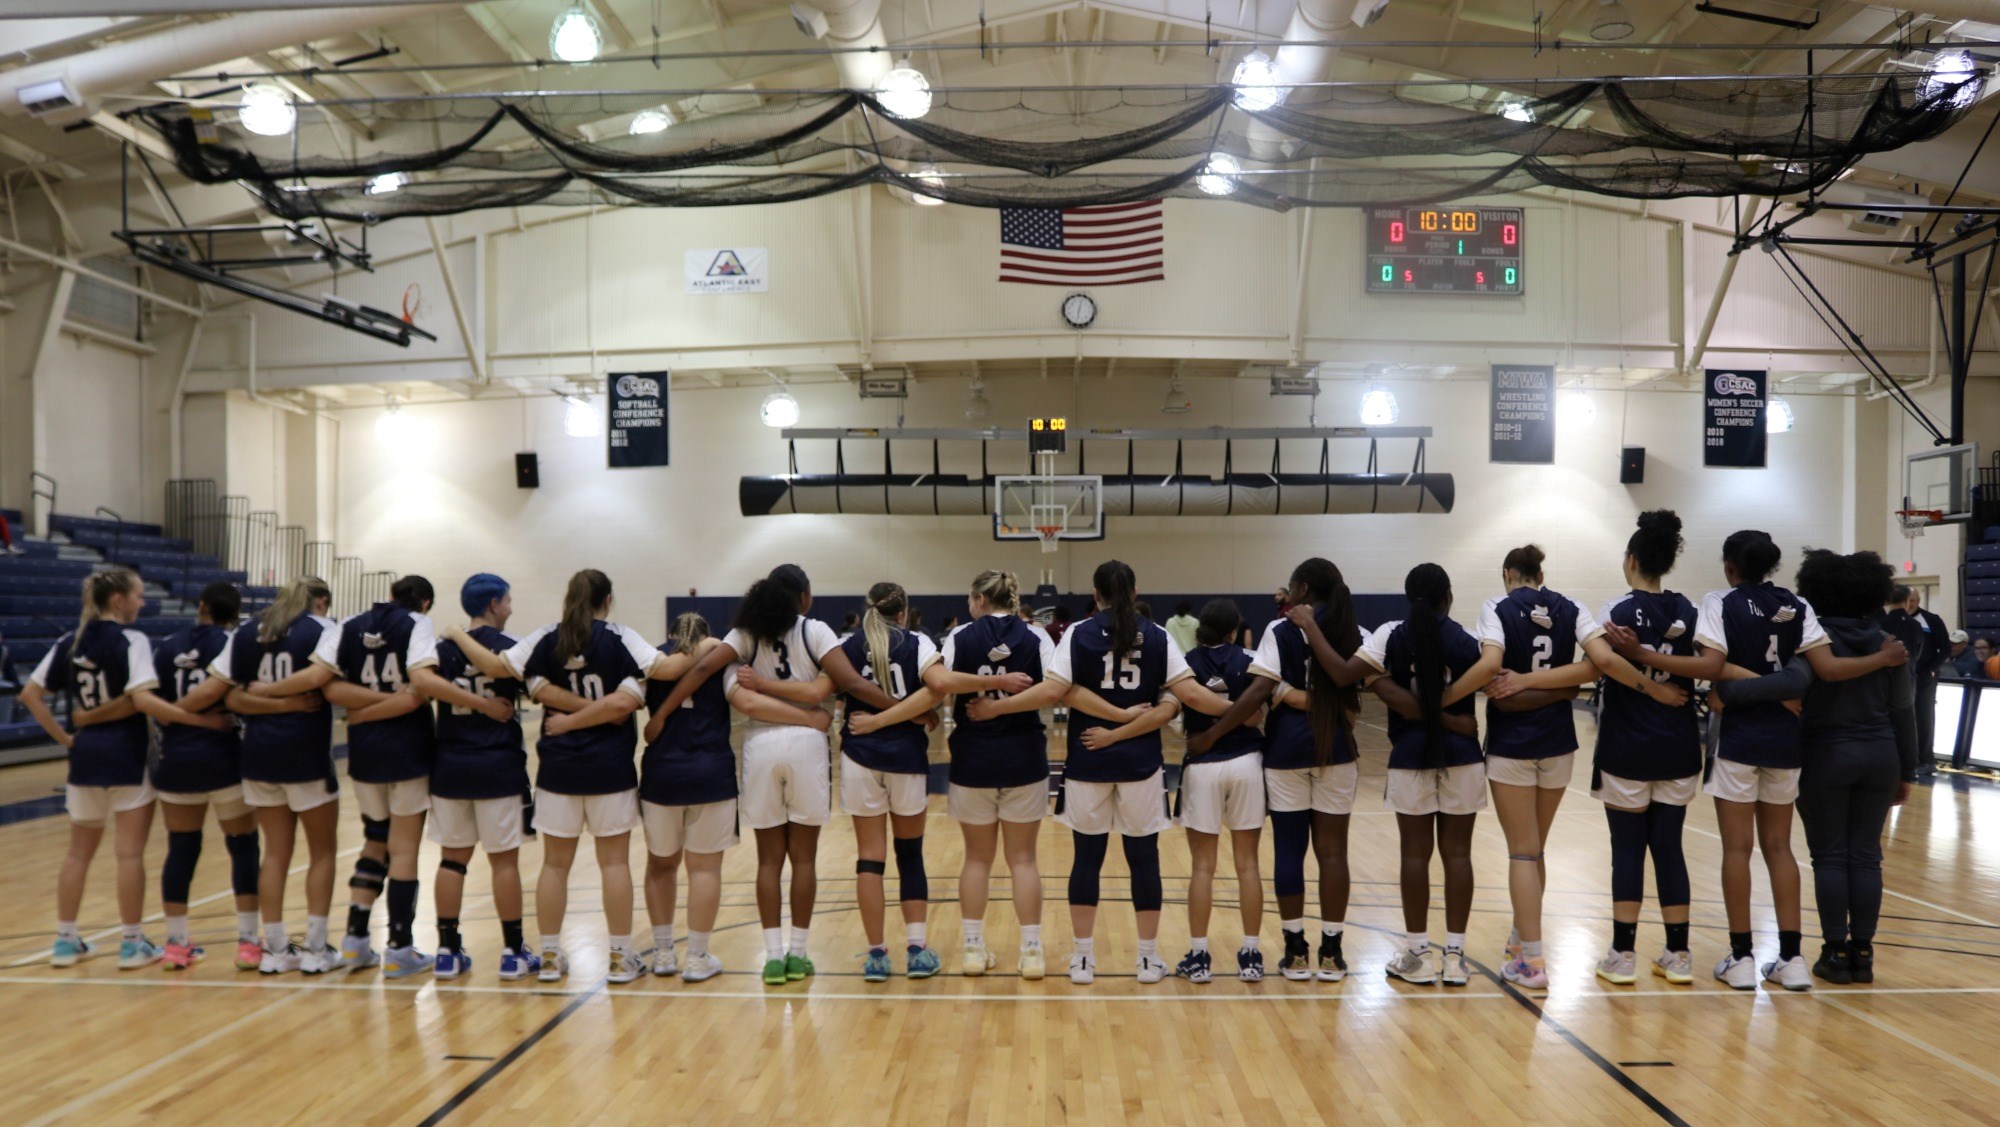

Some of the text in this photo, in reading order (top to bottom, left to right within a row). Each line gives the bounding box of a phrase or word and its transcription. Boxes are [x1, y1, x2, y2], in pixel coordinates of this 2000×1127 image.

[1374, 209, 1402, 219] HOME
[1420, 211, 1476, 232] 10:00
[1482, 211, 1518, 222] VISITOR
[1391, 222, 1403, 242] 0
[1503, 225, 1516, 245] 0
[1458, 240, 1463, 255] 1
[1382, 265, 1392, 282] 0
[1476, 271, 1484, 283] 5
[1505, 267, 1515, 284] 0
[1728, 379, 1756, 390] CSAC
[617, 400, 658, 409] SOFTBALL
[1499, 392, 1546, 402] WRESTLING
[1707, 398, 1764, 408] WOMEN'S SOCCER
[612, 408, 664, 418] CONFERENCE
[1496, 402, 1549, 411] CONFERENCE
[1714, 408, 1757, 417] CONFERENCE
[615, 418, 662, 428] CHAMPIONS
[1499, 411, 1545, 420] CHAMPIONS
[1716, 417, 1754, 426] CHAMPIONS
[772, 640, 792, 680] 3
[1532, 635, 1553, 672] 2
[1765, 634, 1783, 672] 4
[257, 652, 293, 685] 40
[360, 652, 403, 692] 44
[1100, 650, 1142, 690] 15
[76, 669, 111, 708] 21
[568, 672, 604, 702] 10
